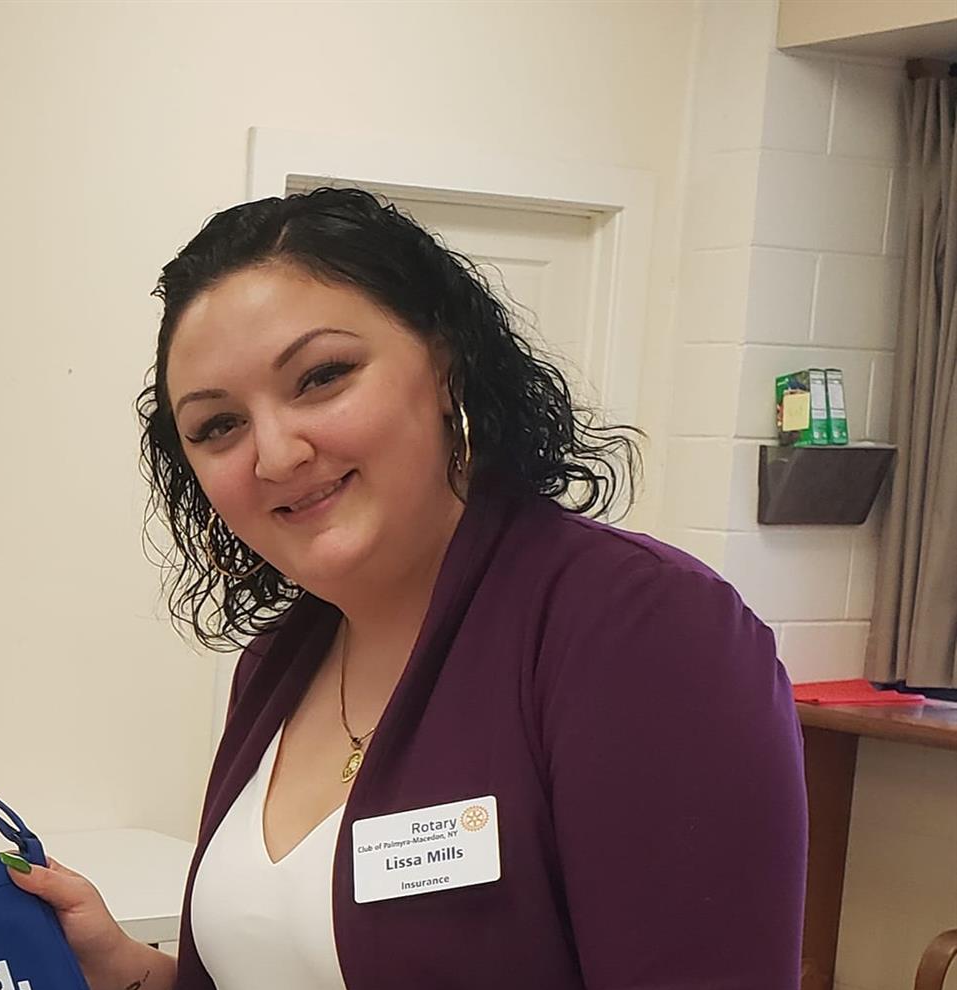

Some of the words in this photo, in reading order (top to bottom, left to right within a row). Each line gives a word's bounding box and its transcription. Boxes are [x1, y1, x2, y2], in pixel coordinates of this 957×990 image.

[411, 818, 457, 834] Rotary
[357, 843, 373, 853] Club
[374, 842, 382, 851] of
[383, 834, 446, 848] Palmyra-Macedon,
[447, 830, 458, 838] NY
[386, 856, 422, 870] Lissa
[427, 846, 464, 863] Mills
[401, 875, 450, 890] Insurance
